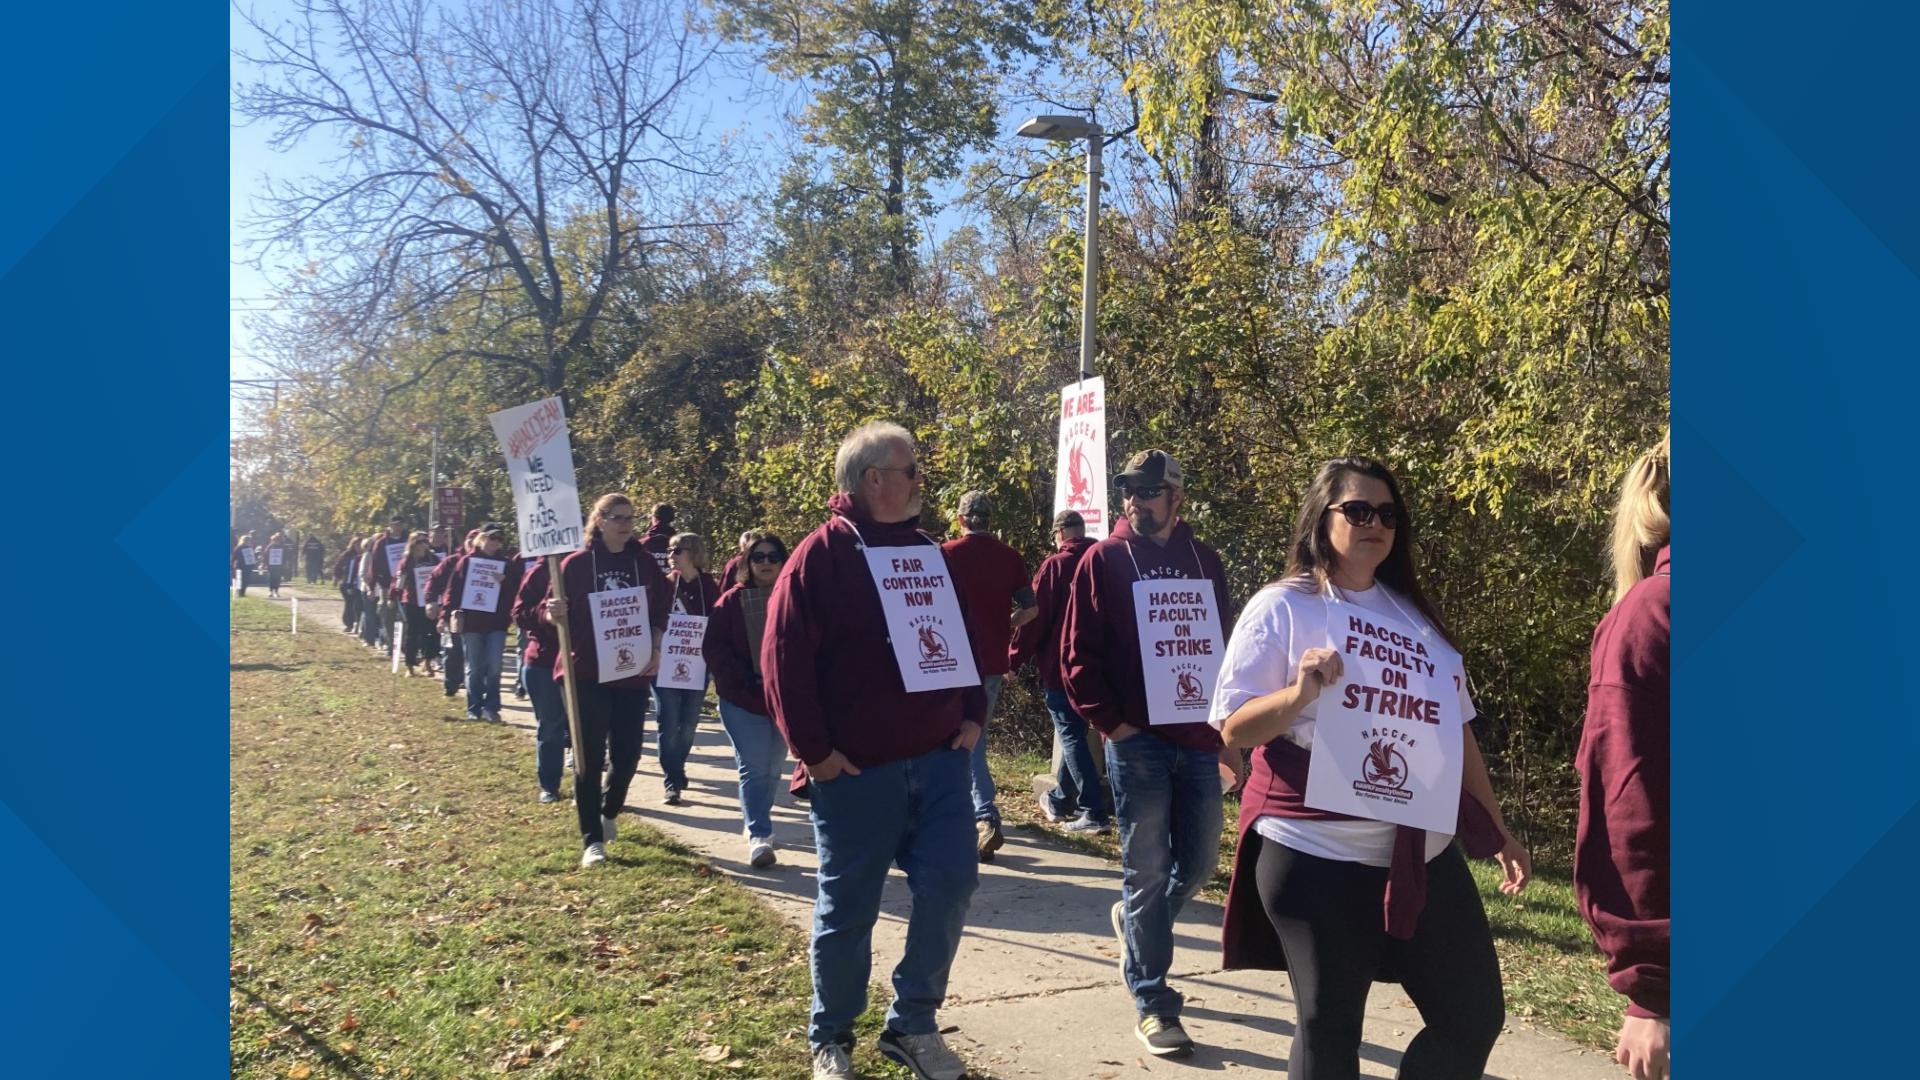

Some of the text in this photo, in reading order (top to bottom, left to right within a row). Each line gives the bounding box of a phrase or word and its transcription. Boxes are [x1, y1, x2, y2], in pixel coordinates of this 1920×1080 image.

[1063, 396, 1075, 419] WE
[526, 454, 545, 474] WE
[524, 474, 554, 494] NEED
[537, 494, 546, 509] A
[528, 509, 558, 529] FAIR
[891, 558, 925, 573] FAIR
[882, 575, 945, 591] CONTRACT
[600, 595, 639, 609] HACCEA
[904, 591, 934, 607] NOW
[1149, 591, 1204, 606] HACCEA
[599, 605, 641, 620] FACULTY
[1148, 607, 1208, 623] FACULTY
[617, 618, 629, 627] ON
[671, 620, 704, 630] HACCEA
[907, 614, 943, 629] HACCEA
[604, 624, 643, 641] STRIKE
[669, 628, 704, 638] FACULTY
[1174, 624, 1191, 637] ON
[1348, 615, 1430, 658] HACCEA
[667, 645, 702, 657] STRIKE
[1154, 638, 1213, 657] STRIKE
[1345, 636, 1436, 678] FACULTY
[1381, 667, 1408, 690] ON
[1342, 683, 1441, 725] STRIKE
[1361, 727, 1417, 748] HACCEA
